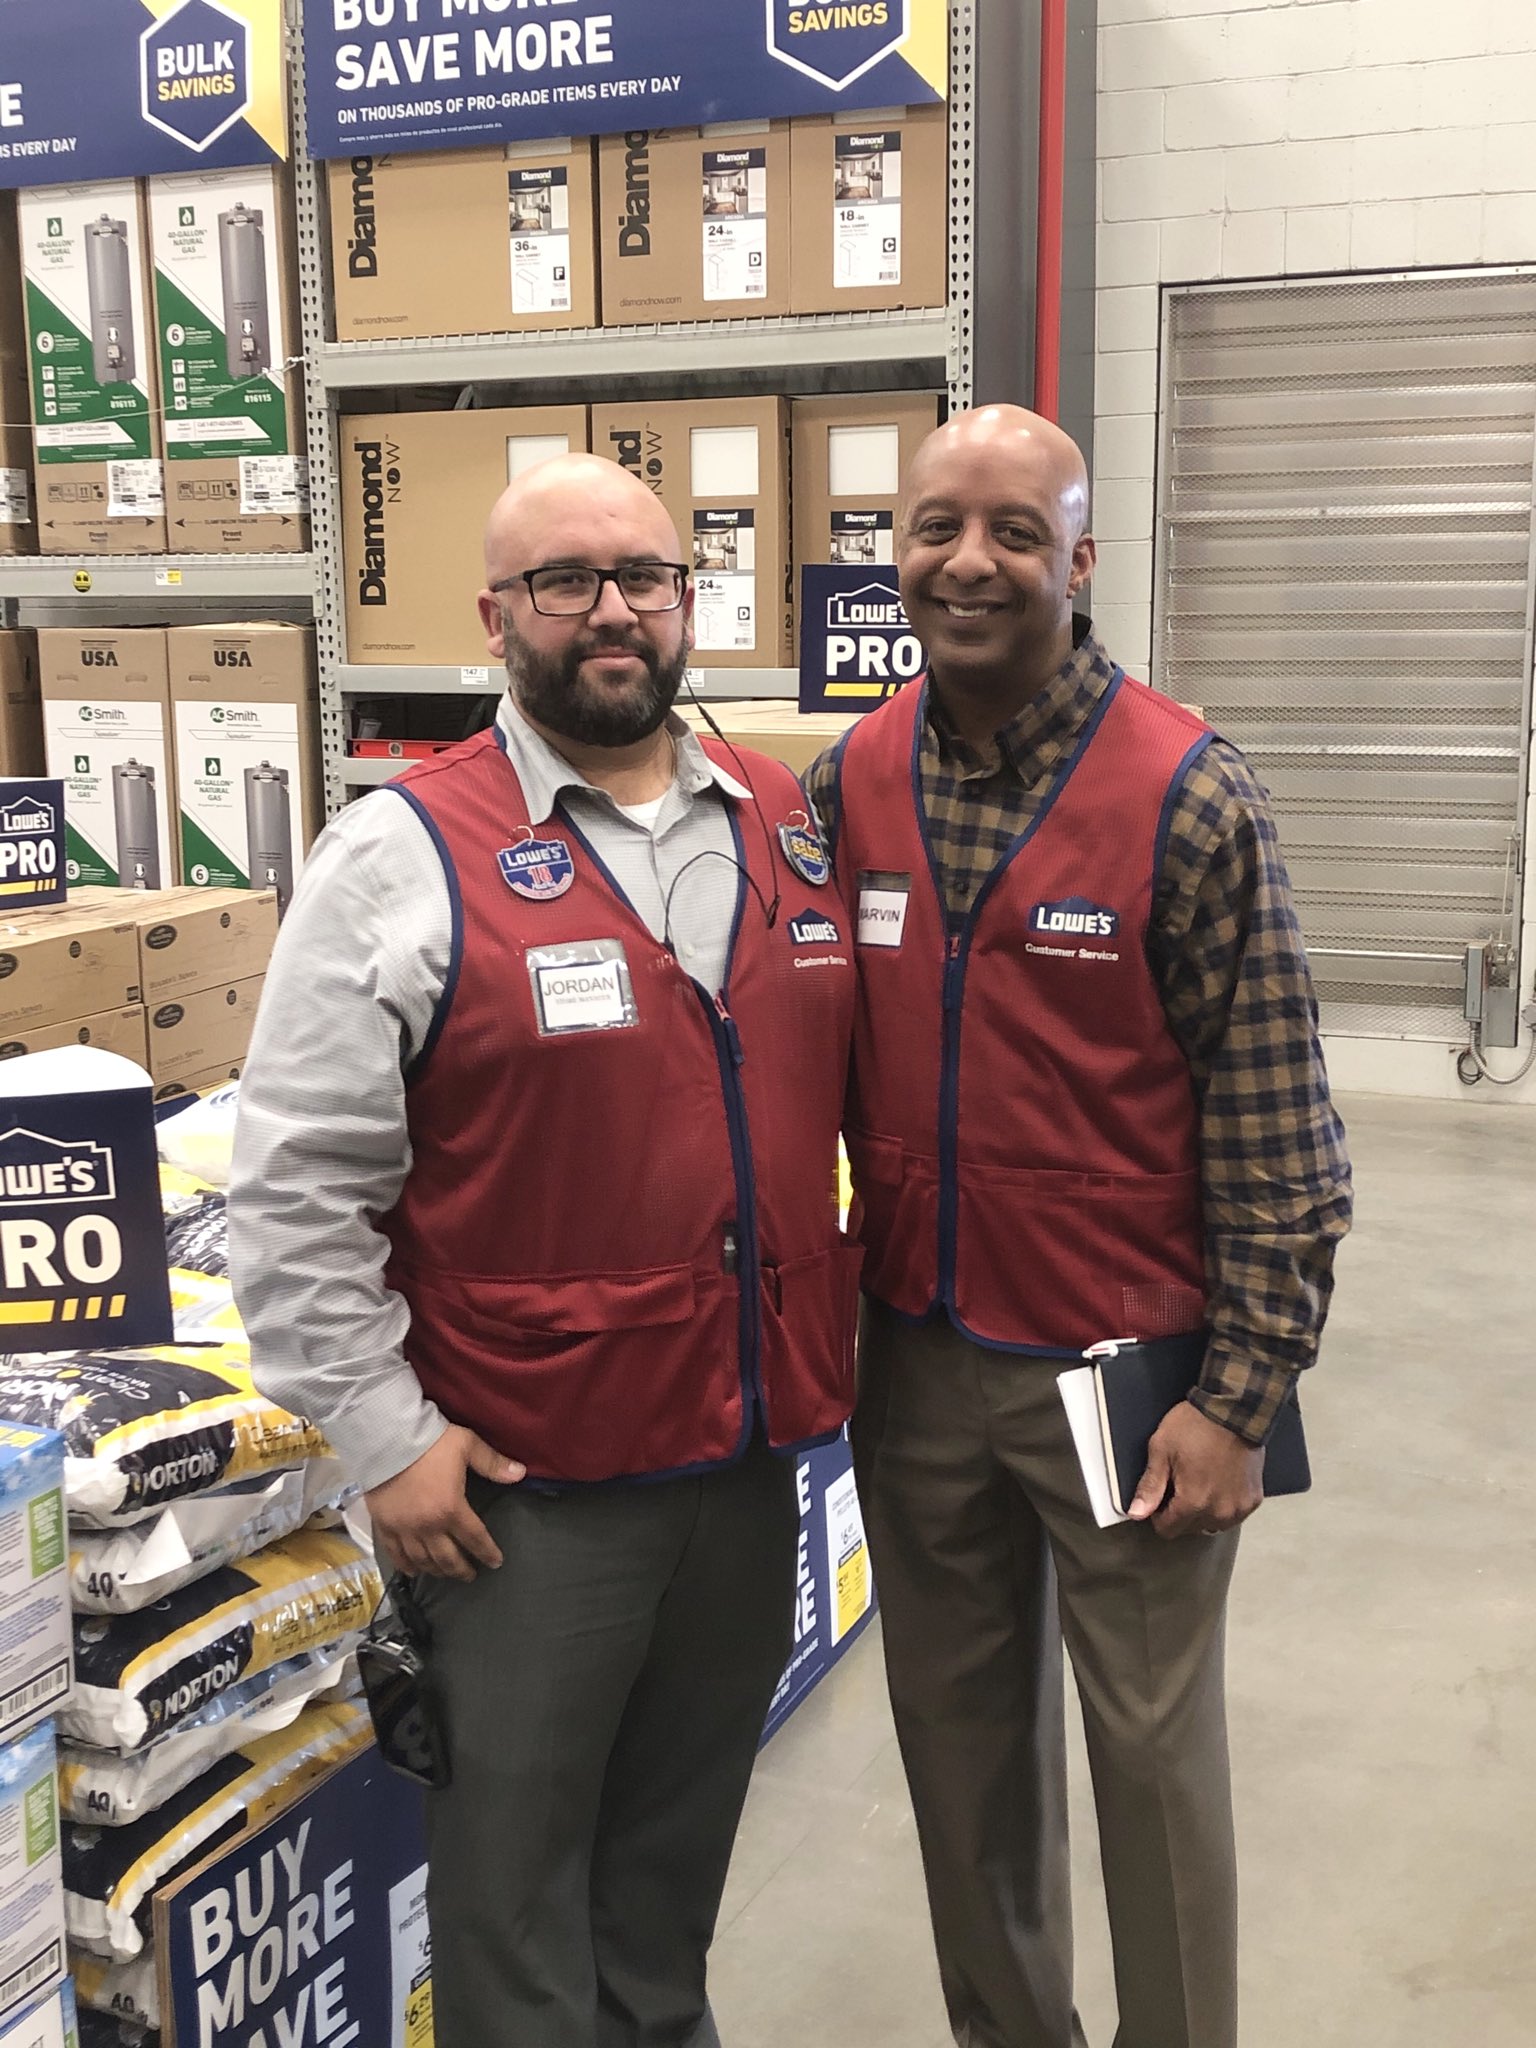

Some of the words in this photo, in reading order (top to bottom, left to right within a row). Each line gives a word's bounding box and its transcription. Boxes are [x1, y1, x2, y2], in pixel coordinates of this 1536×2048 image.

[789, 3, 888, 33] SAVINGS
[157, 39, 235, 78] BULK
[335, 32, 460, 91] SAVE
[474, 14, 613, 76] MORE
[158, 74, 236, 101] SAVINGS
[338, 109, 357, 124] ON
[360, 101, 443, 121] THOUSANDS
[446, 98, 464, 113] OF
[467, 90, 549, 112] PRO-GRADE
[553, 84, 597, 103] ITEMS
[600, 78, 648, 98] EVERY
[651, 76, 681, 92] DAY
[12, 140, 50, 156] EVERY
[52, 137, 77, 153] DAY
[850, 135, 884, 146] Diamond
[717, 152, 749, 162] Diamond
[521, 170, 552, 181] Diamond
[618, 130, 651, 257] Diamo
[348, 155, 377, 278] Diamo
[354, 441, 387, 605] Diamond
[706, 512, 738, 521] Diamond
[844, 514, 877, 523] Diamond
[739, 608, 750, 619] D
[82, 651, 118, 666] USA
[214, 651, 252, 667] USA
[826, 635, 923, 677] PRO
[199, 786, 230, 794] NATURAL
[4, 811, 49, 831] LOWE'S
[0, 839, 56, 877] PRO
[505, 846, 562, 867] LOWE'S
[195, 868, 204, 881] 6
[527, 865, 552, 885] 18
[791, 921, 838, 943] LOWE'S
[1036, 907, 1113, 935] LOWE'S
[1025, 943, 1077, 957] Customer
[1078, 948, 1119, 961] Service
[544, 977, 615, 996] JORDAN
[0, 1156, 96, 1196] WE'S
[0, 1214, 122, 1288] RO
[88, 1572, 113, 1598] 40
[164, 1655, 239, 1720] MORTON
[88, 1790, 111, 1812] 40
[190, 1817, 312, 1978] BUY
[197, 1858, 355, 2048] MORE
[249, 1956, 345, 2048] VE
